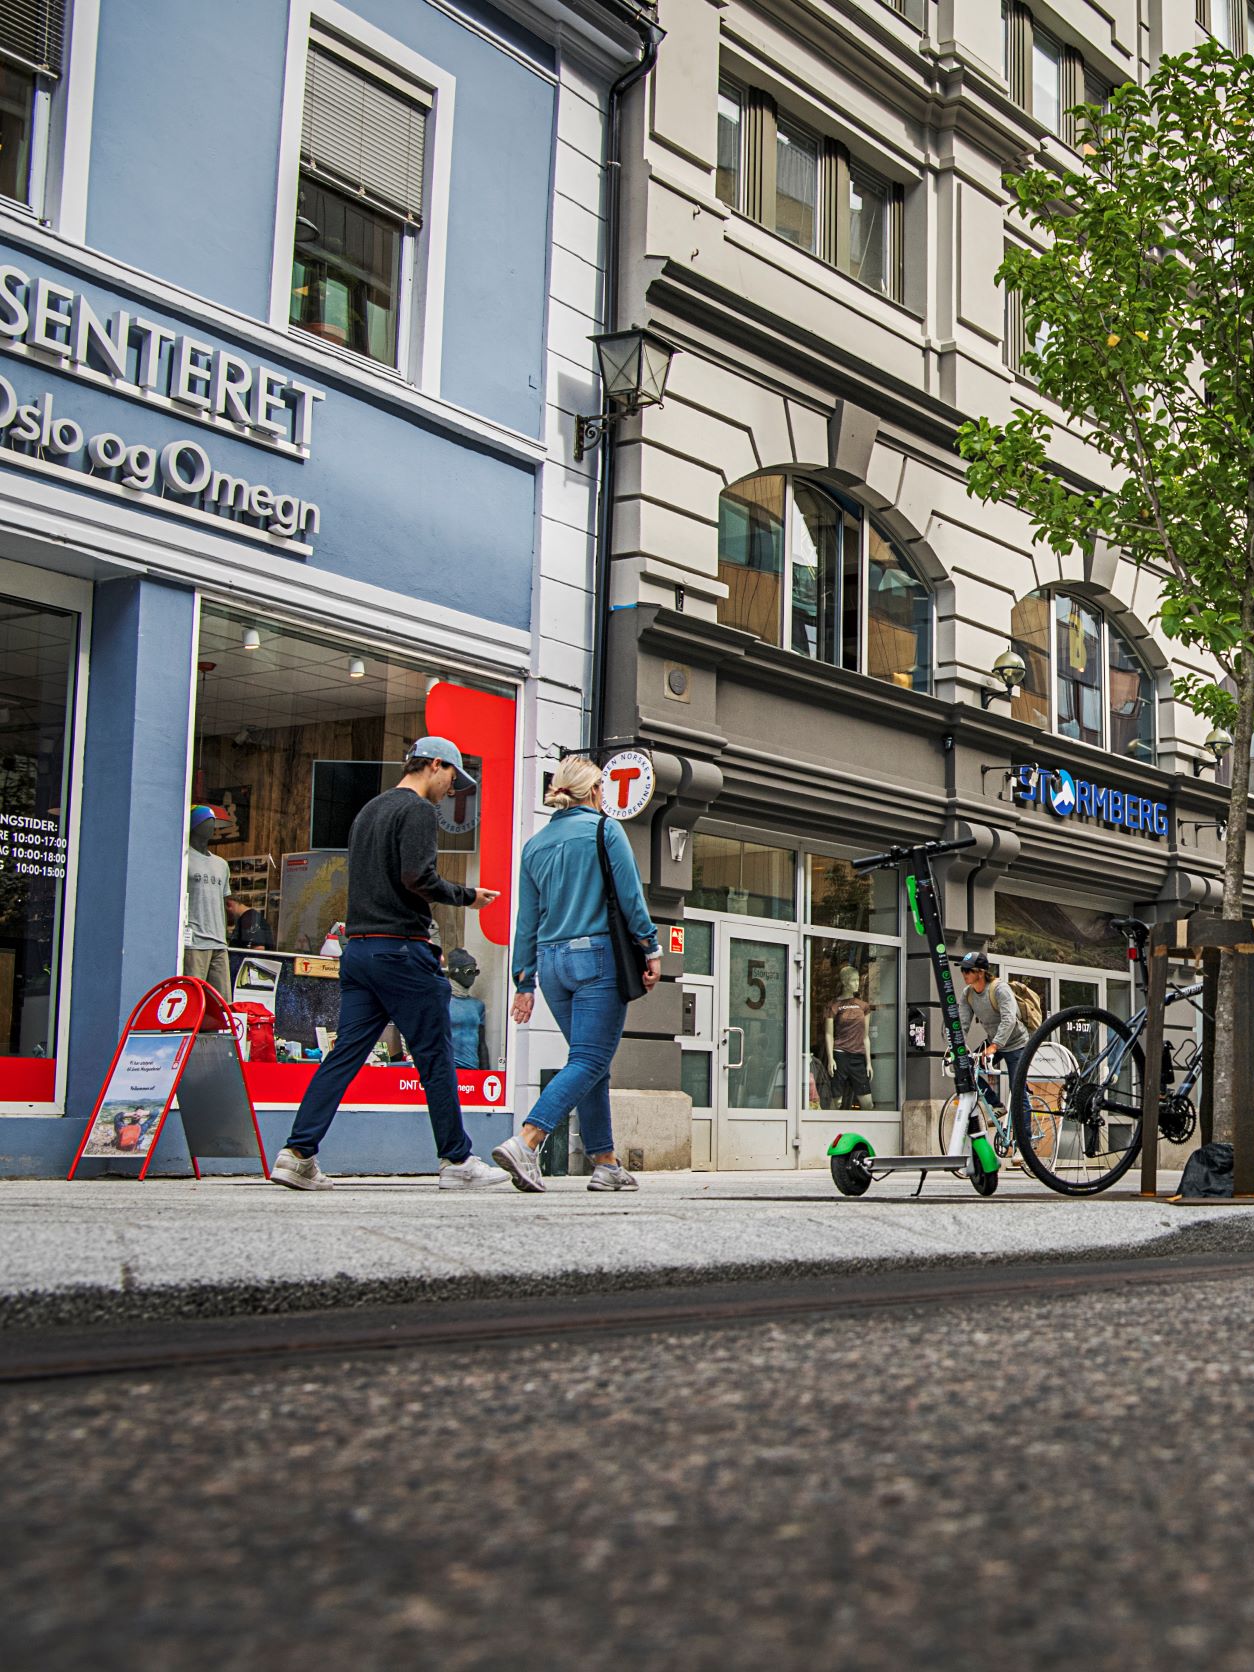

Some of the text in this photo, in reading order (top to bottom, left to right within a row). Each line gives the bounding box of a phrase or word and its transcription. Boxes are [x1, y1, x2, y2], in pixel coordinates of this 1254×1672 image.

[0, 264, 326, 447] SENTERET
[88, 432, 157, 490] og
[160, 440, 320, 536] Omegn
[603, 753, 650, 777] DEN NORSKE
[610, 767, 641, 809] T
[0, 813, 58, 832] NGSTIDER:
[12, 832, 67, 849] 10:00-17:00
[12, 847, 66, 864] 10:00-18:00
[16, 862, 65, 879] 10:00-15:00
[746, 959, 766, 1010] 5
[167, 997, 183, 1018] T
[400, 1080, 418, 1090] DNT
[488, 1082, 497, 1097] T
